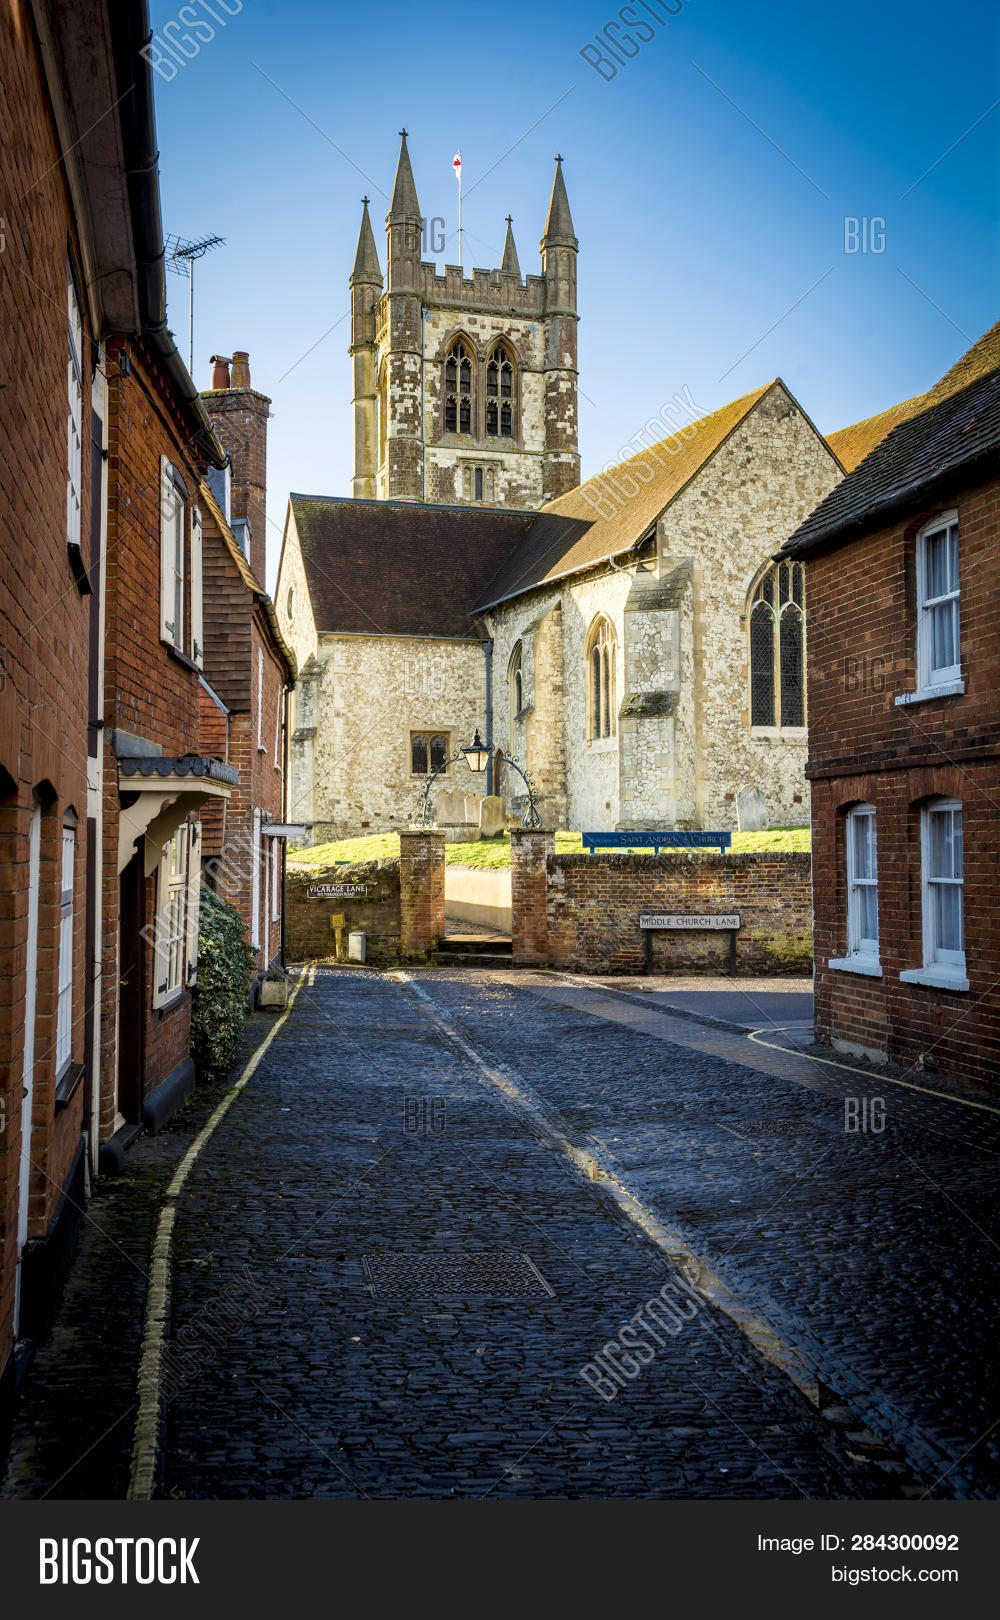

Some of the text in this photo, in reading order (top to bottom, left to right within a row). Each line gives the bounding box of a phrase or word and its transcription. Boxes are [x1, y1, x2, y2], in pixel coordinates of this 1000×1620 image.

[309, 885, 344, 893] VICARAGE
[641, 918, 738, 926] MIDDLE CHURCH LANE
